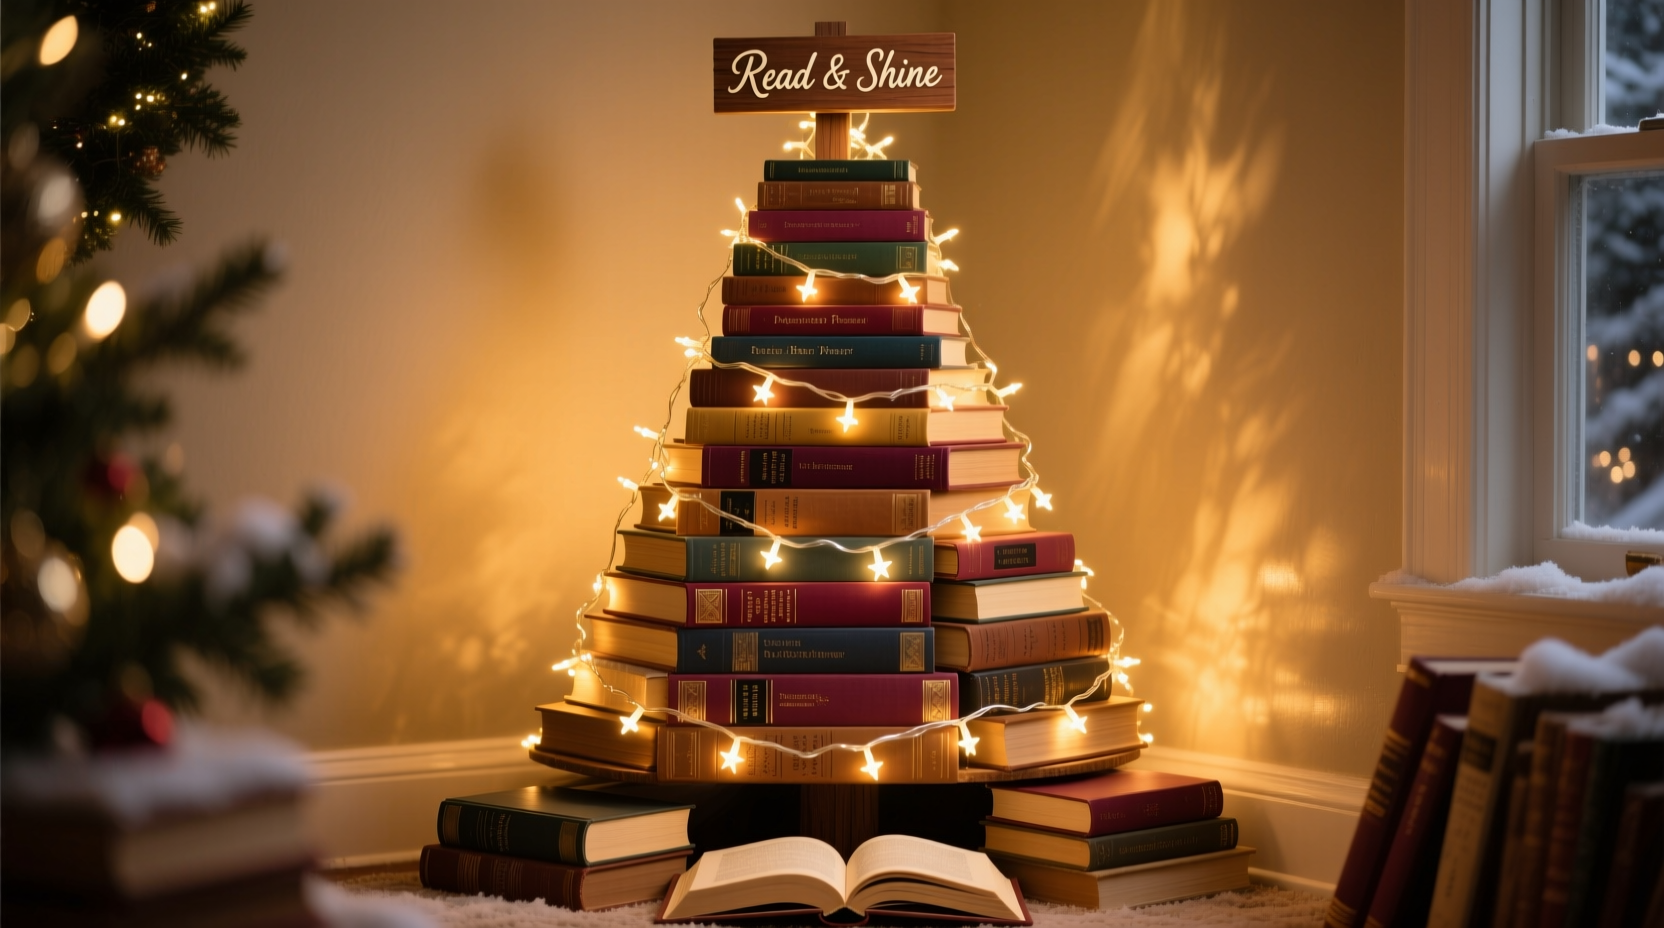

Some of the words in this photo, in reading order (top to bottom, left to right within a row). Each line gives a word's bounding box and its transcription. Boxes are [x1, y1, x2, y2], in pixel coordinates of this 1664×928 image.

[728, 49, 818, 98] Read
[823, 53, 850, 90] &
[856, 48, 942, 92] Shine
